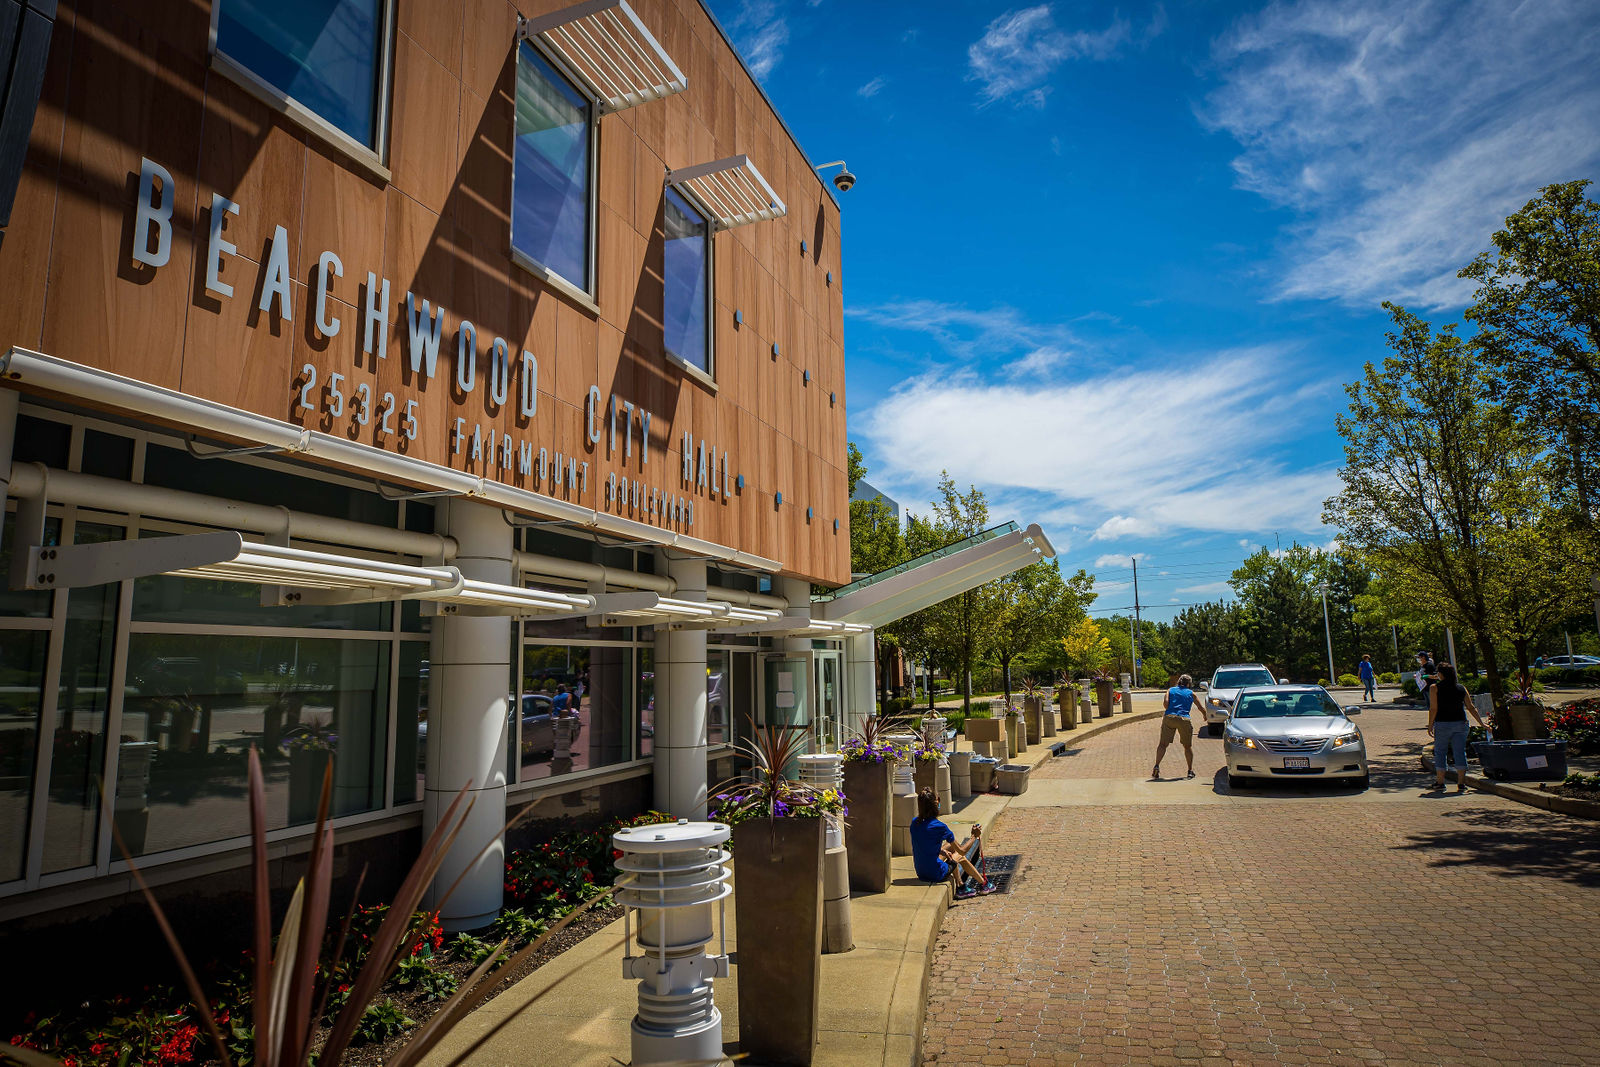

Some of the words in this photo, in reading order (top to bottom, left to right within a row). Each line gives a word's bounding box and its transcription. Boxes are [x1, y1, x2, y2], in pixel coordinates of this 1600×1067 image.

[132, 157, 538, 417] BEACHWOOD
[589, 385, 651, 464] CITY
[683, 430, 731, 498] HALL
[300, 363, 419, 441] 25325
[455, 417, 589, 493] FAIRMOUNT
[609, 471, 694, 527] BOULEVARD
